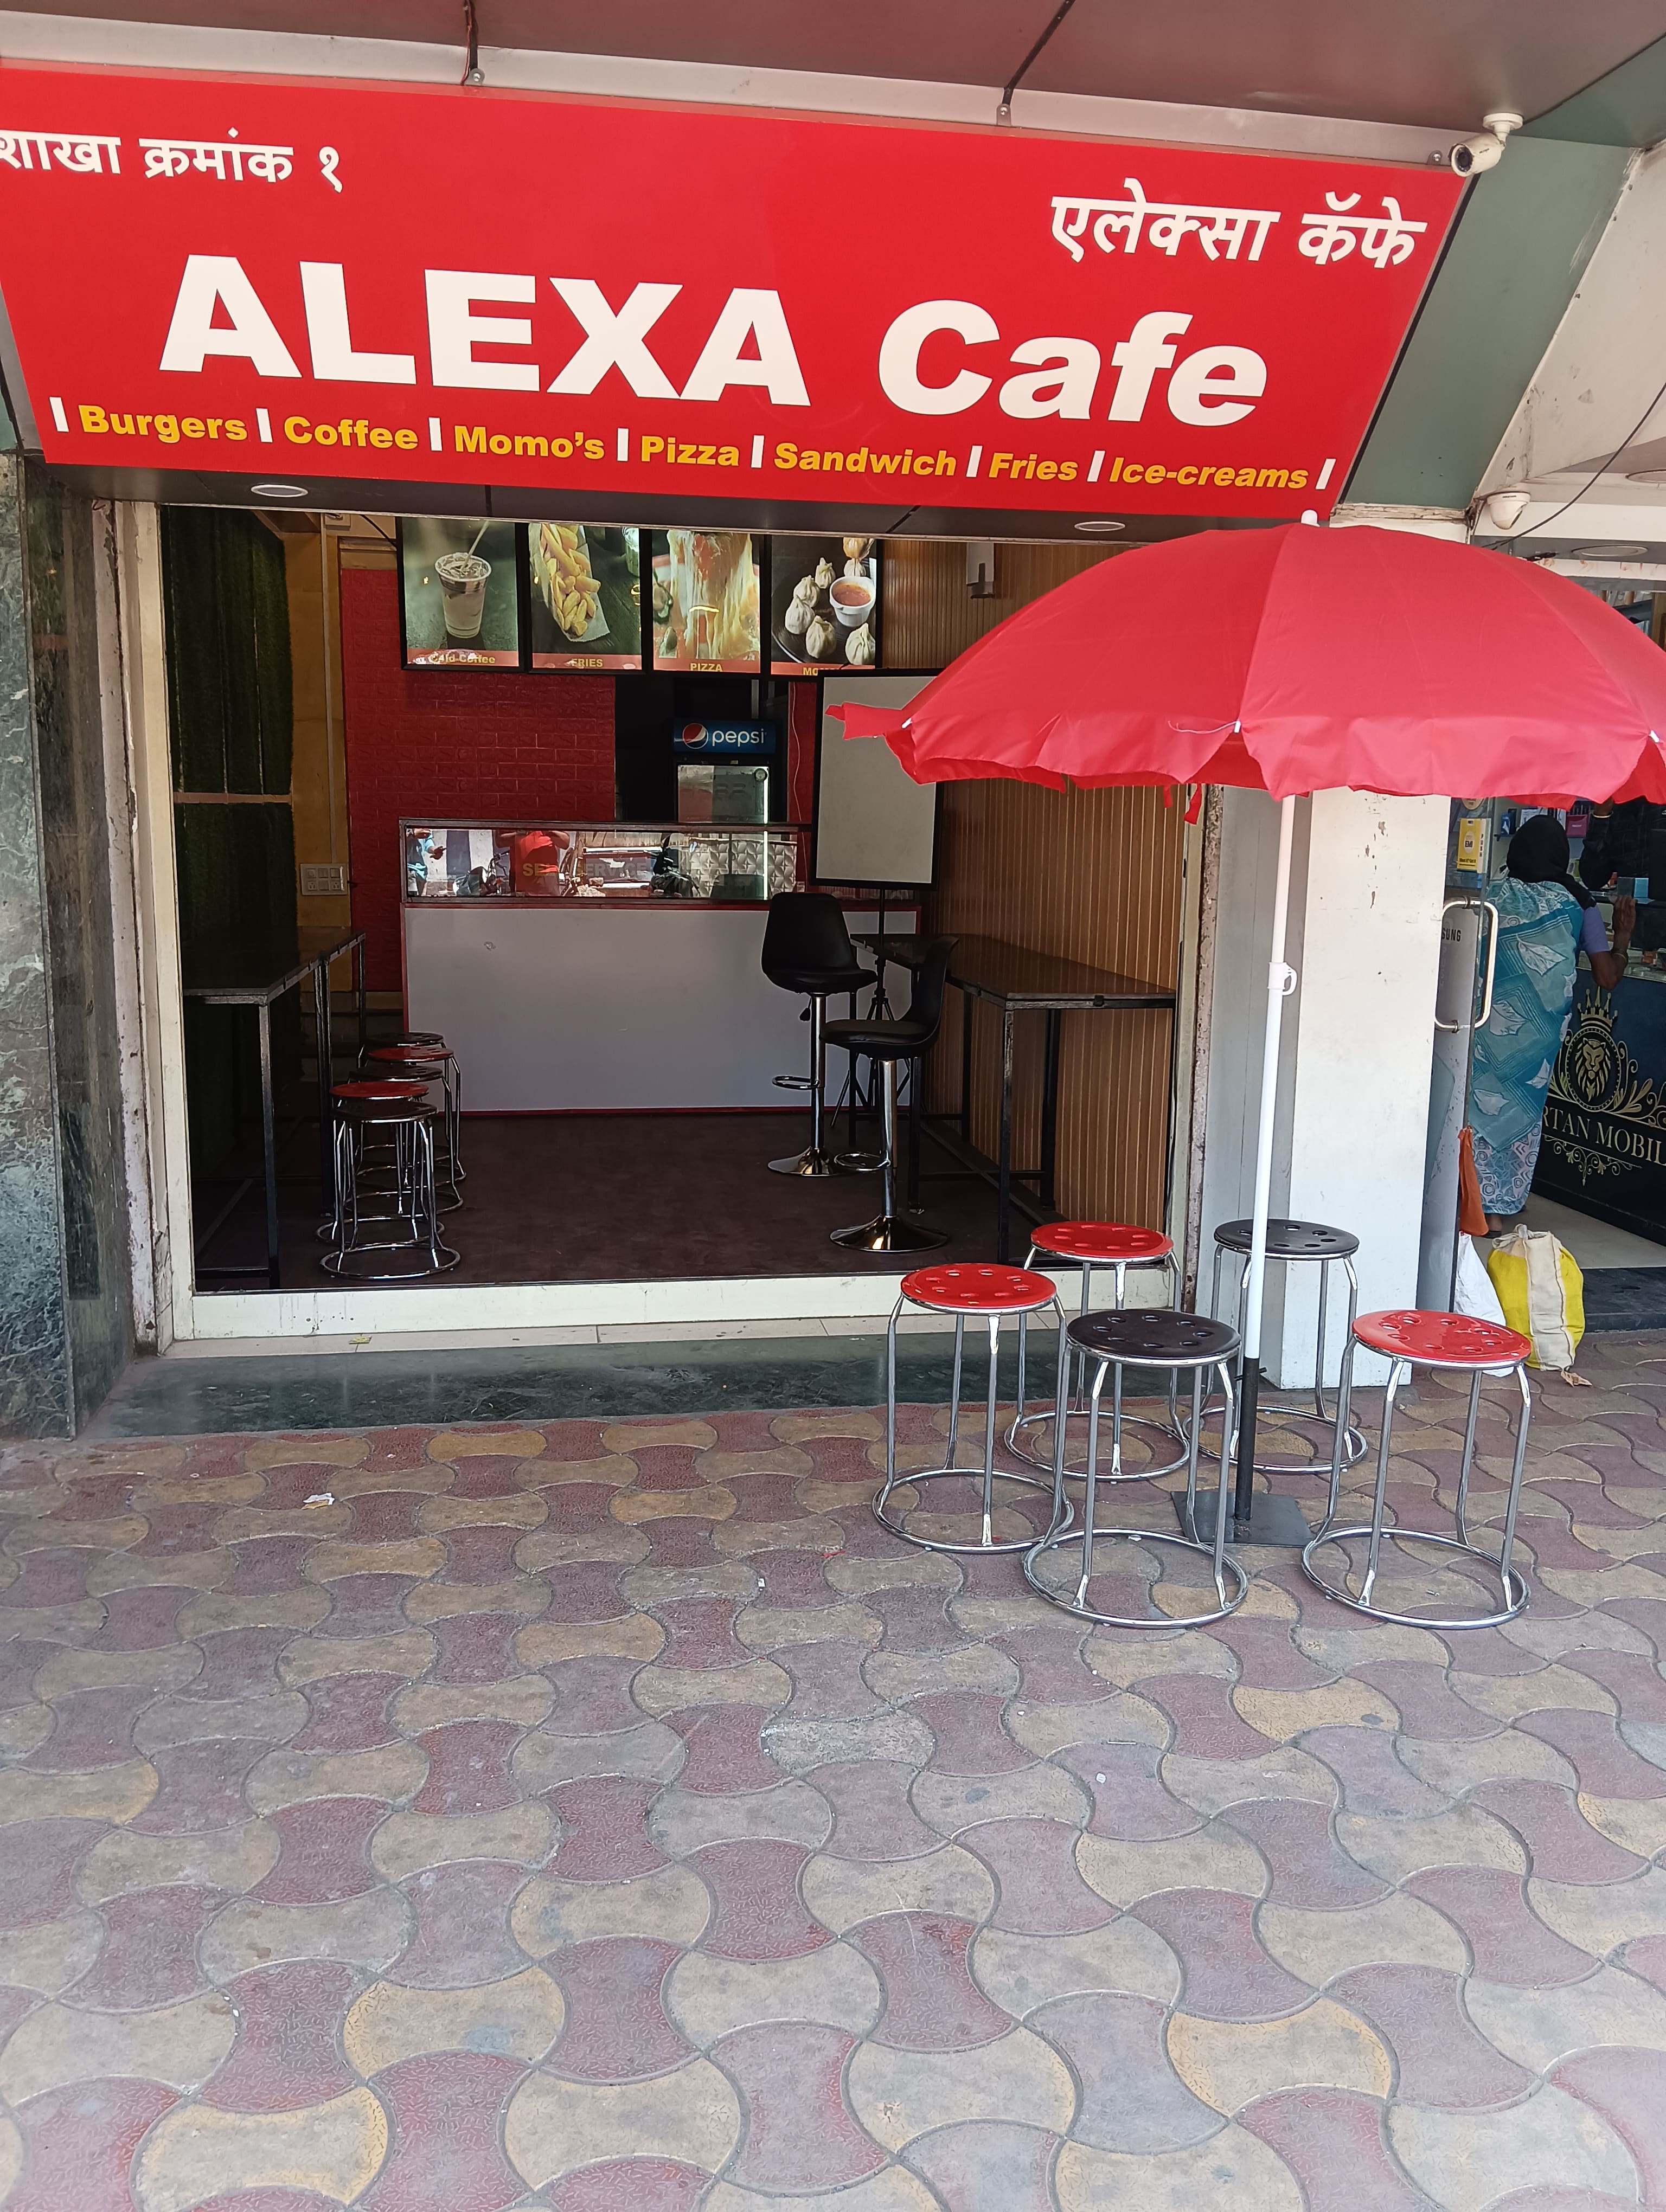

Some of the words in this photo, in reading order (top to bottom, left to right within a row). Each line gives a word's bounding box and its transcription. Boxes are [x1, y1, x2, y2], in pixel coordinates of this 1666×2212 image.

[0, 129, 121, 174] शाखा
[138, 127, 293, 182] क्रमांक
[319, 146, 343, 192] १
[1050, 178, 1281, 263] एलेक्सा
[1298, 191, 1428, 268] कॅफे
[159, 254, 810, 406] ALEXA
[879, 300, 1267, 426] Cafe
[79, 405, 247, 443] Burgers
[284, 416, 418, 449] Coffee
[454, 425, 604, 459] Momo’s
[641, 435, 739, 466] Pizza
[774, 442, 956, 475] Sandwich
[989, 453, 1078, 480] Fries
[1109, 457, 1309, 488] Ice-creams
[571, 658, 603, 667] FRIES
[690, 663, 723, 672] PIZZA
[712, 728, 764, 747] pepsi
[1441, 927, 1462, 942] SUNG
[1595, 1122, 1666, 1167] MOBIL
